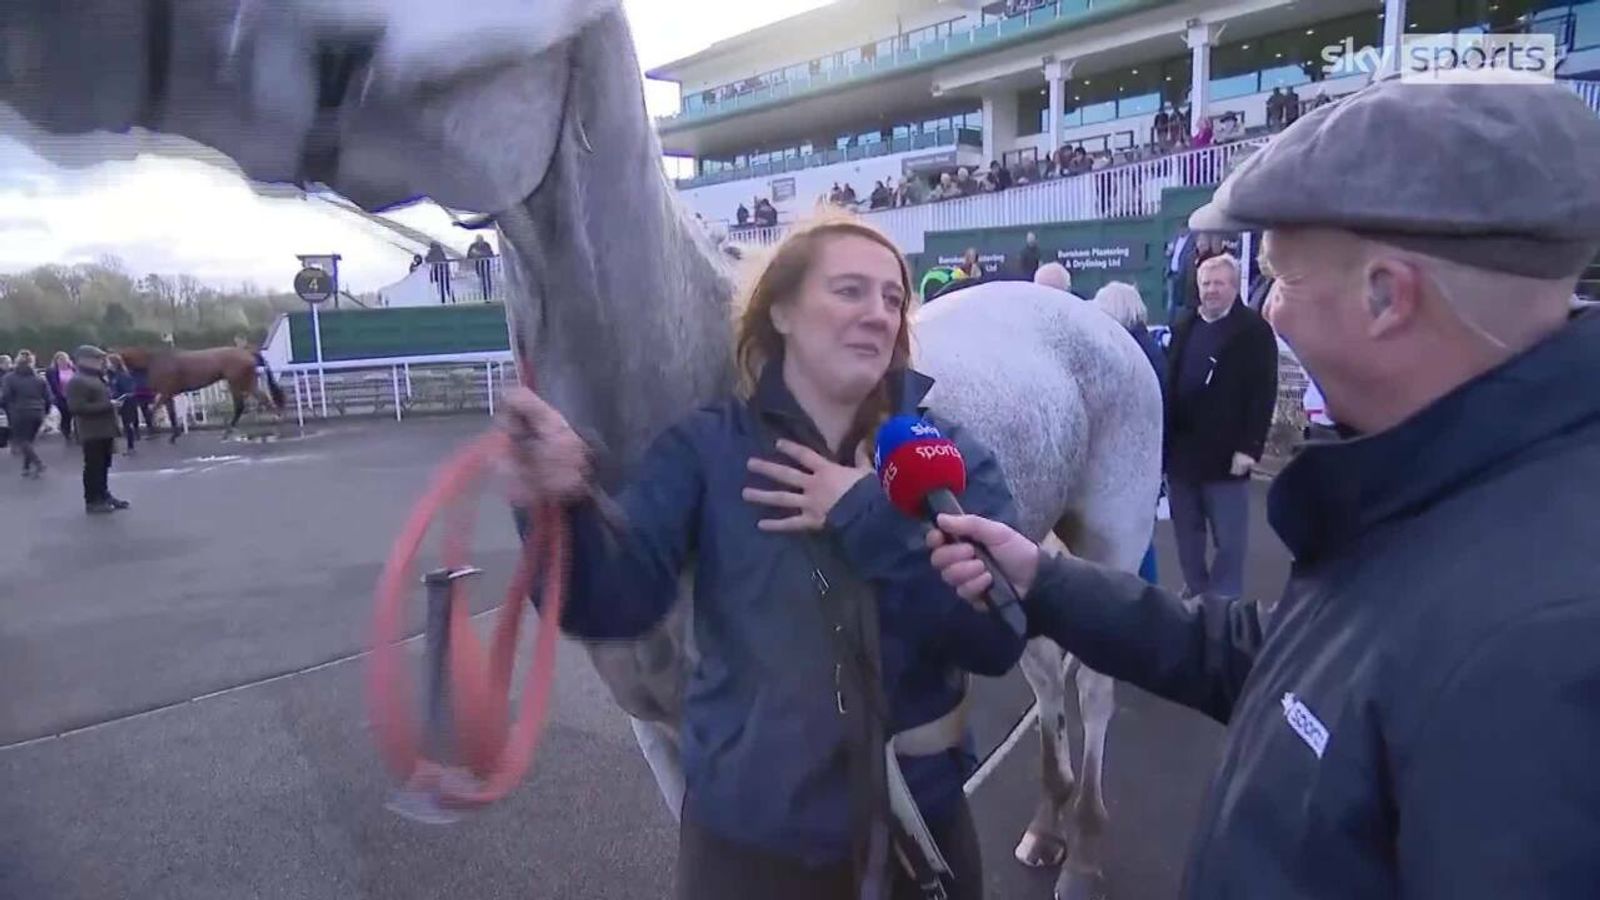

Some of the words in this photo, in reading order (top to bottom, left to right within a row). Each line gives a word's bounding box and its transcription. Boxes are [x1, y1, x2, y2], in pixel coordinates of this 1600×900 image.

[1092, 247, 1129, 257] Plastering
[1108, 257, 1121, 267] Ltd
[309, 278, 318, 289] 4
